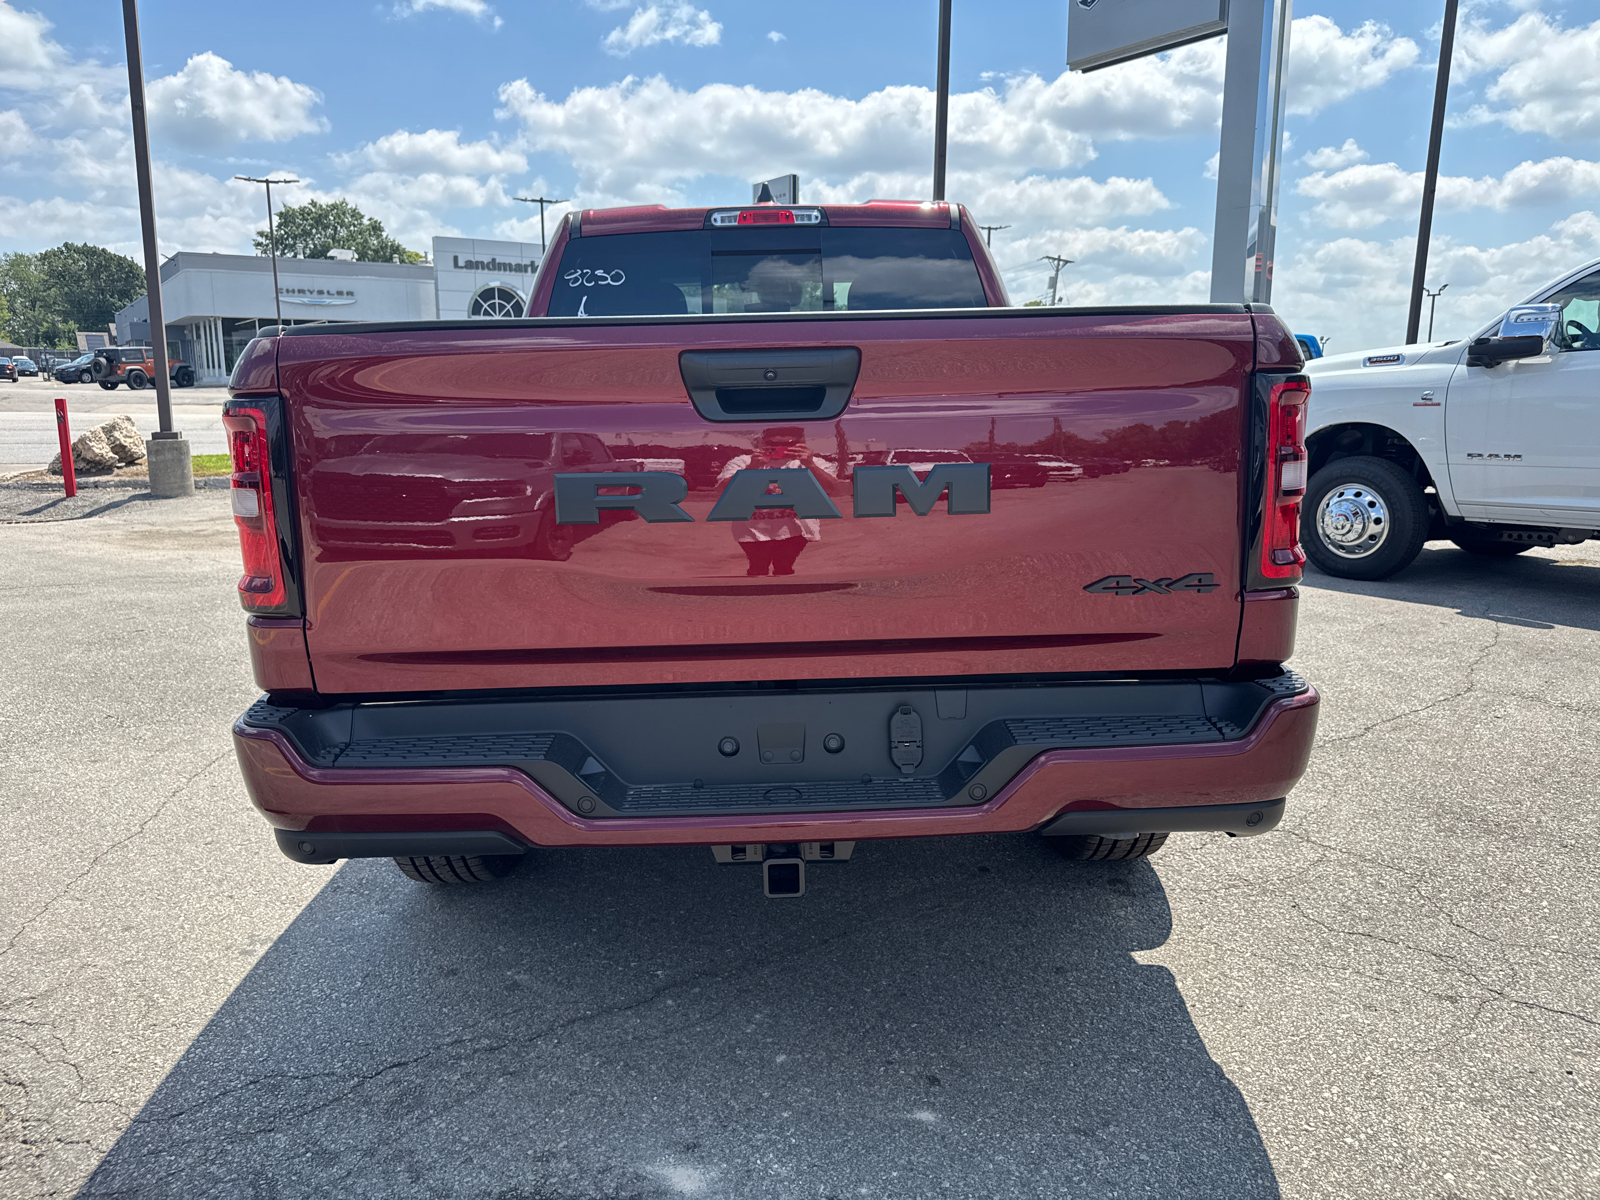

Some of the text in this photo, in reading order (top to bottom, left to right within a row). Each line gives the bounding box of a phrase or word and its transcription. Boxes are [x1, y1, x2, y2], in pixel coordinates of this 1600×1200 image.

[453, 255, 539, 274] Landmark
[564, 269, 626, 287] 8230
[278, 288, 355, 296] CHRYSLER
[1466, 453, 1522, 461] RAM
[553, 463, 991, 525] RAM
[1083, 572, 1221, 596] 4x4
